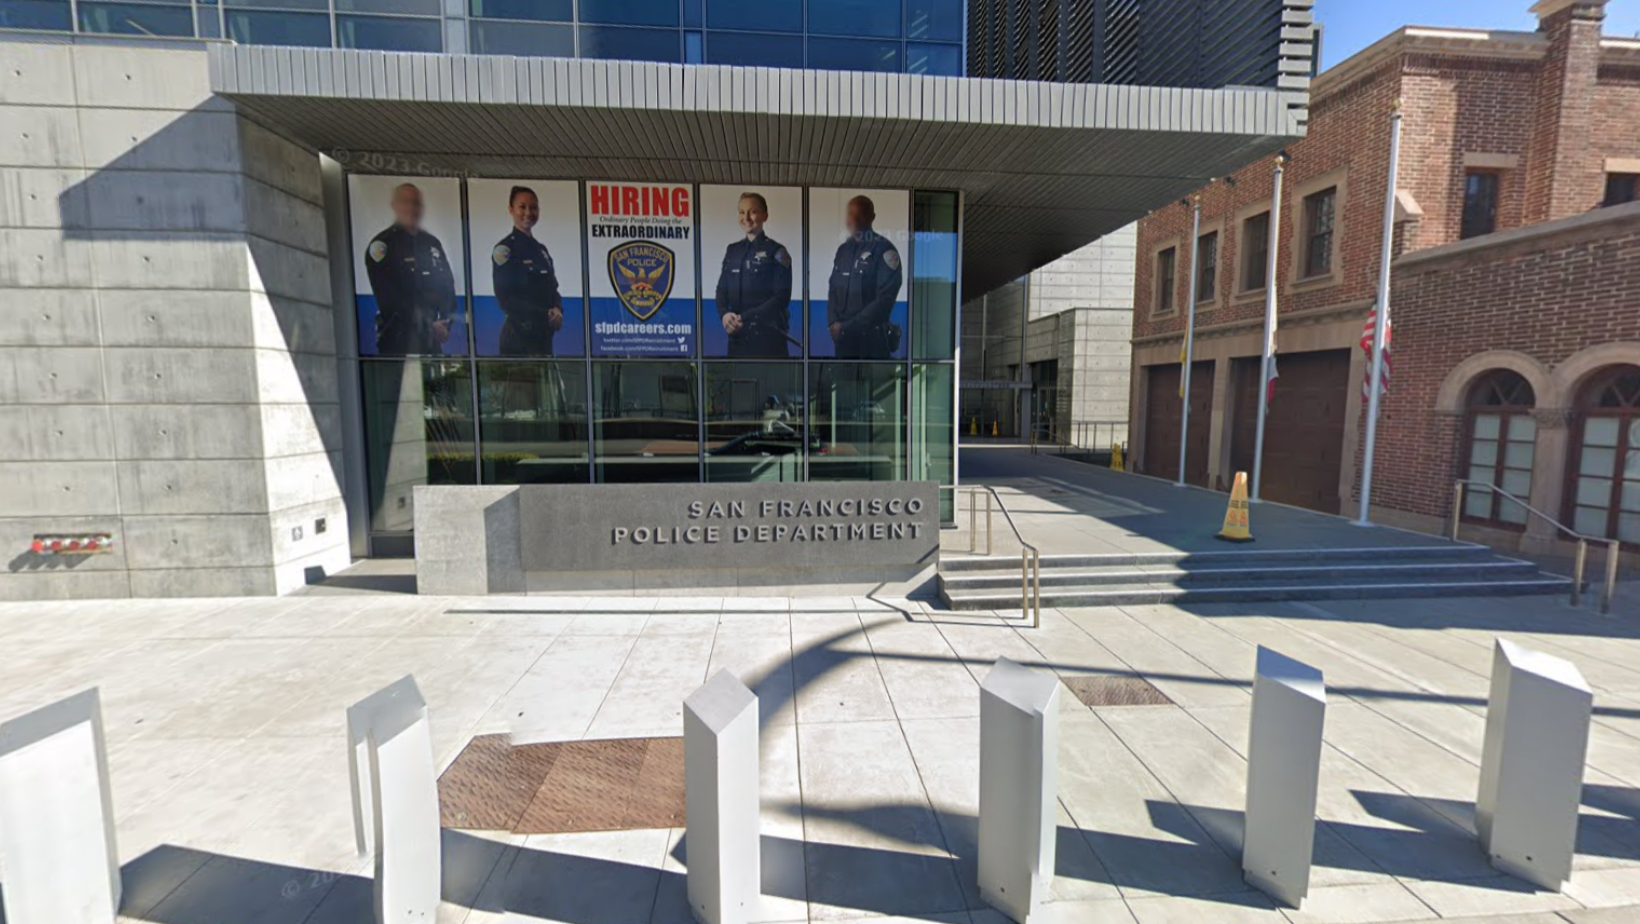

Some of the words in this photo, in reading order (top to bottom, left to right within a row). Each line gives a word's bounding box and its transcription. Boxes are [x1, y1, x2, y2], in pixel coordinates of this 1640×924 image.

[590, 185, 689, 217] HIRING
[599, 216, 629, 225] Ordinary
[629, 216, 650, 226] People
[651, 217, 671, 225] Doing
[672, 217, 682, 225] the
[592, 224, 690, 239] EXTRAORDINARY
[614, 248, 630, 262] SAN
[629, 246, 670, 263] FRANCISCO
[627, 258, 657, 266] POLICE
[594, 321, 692, 335] sfpdcareers.com
[688, 500, 746, 518] SAN
[760, 497, 924, 518] FRANCISCO
[612, 525, 721, 544] POLICE
[733, 521, 925, 543] DEPARTMENT
